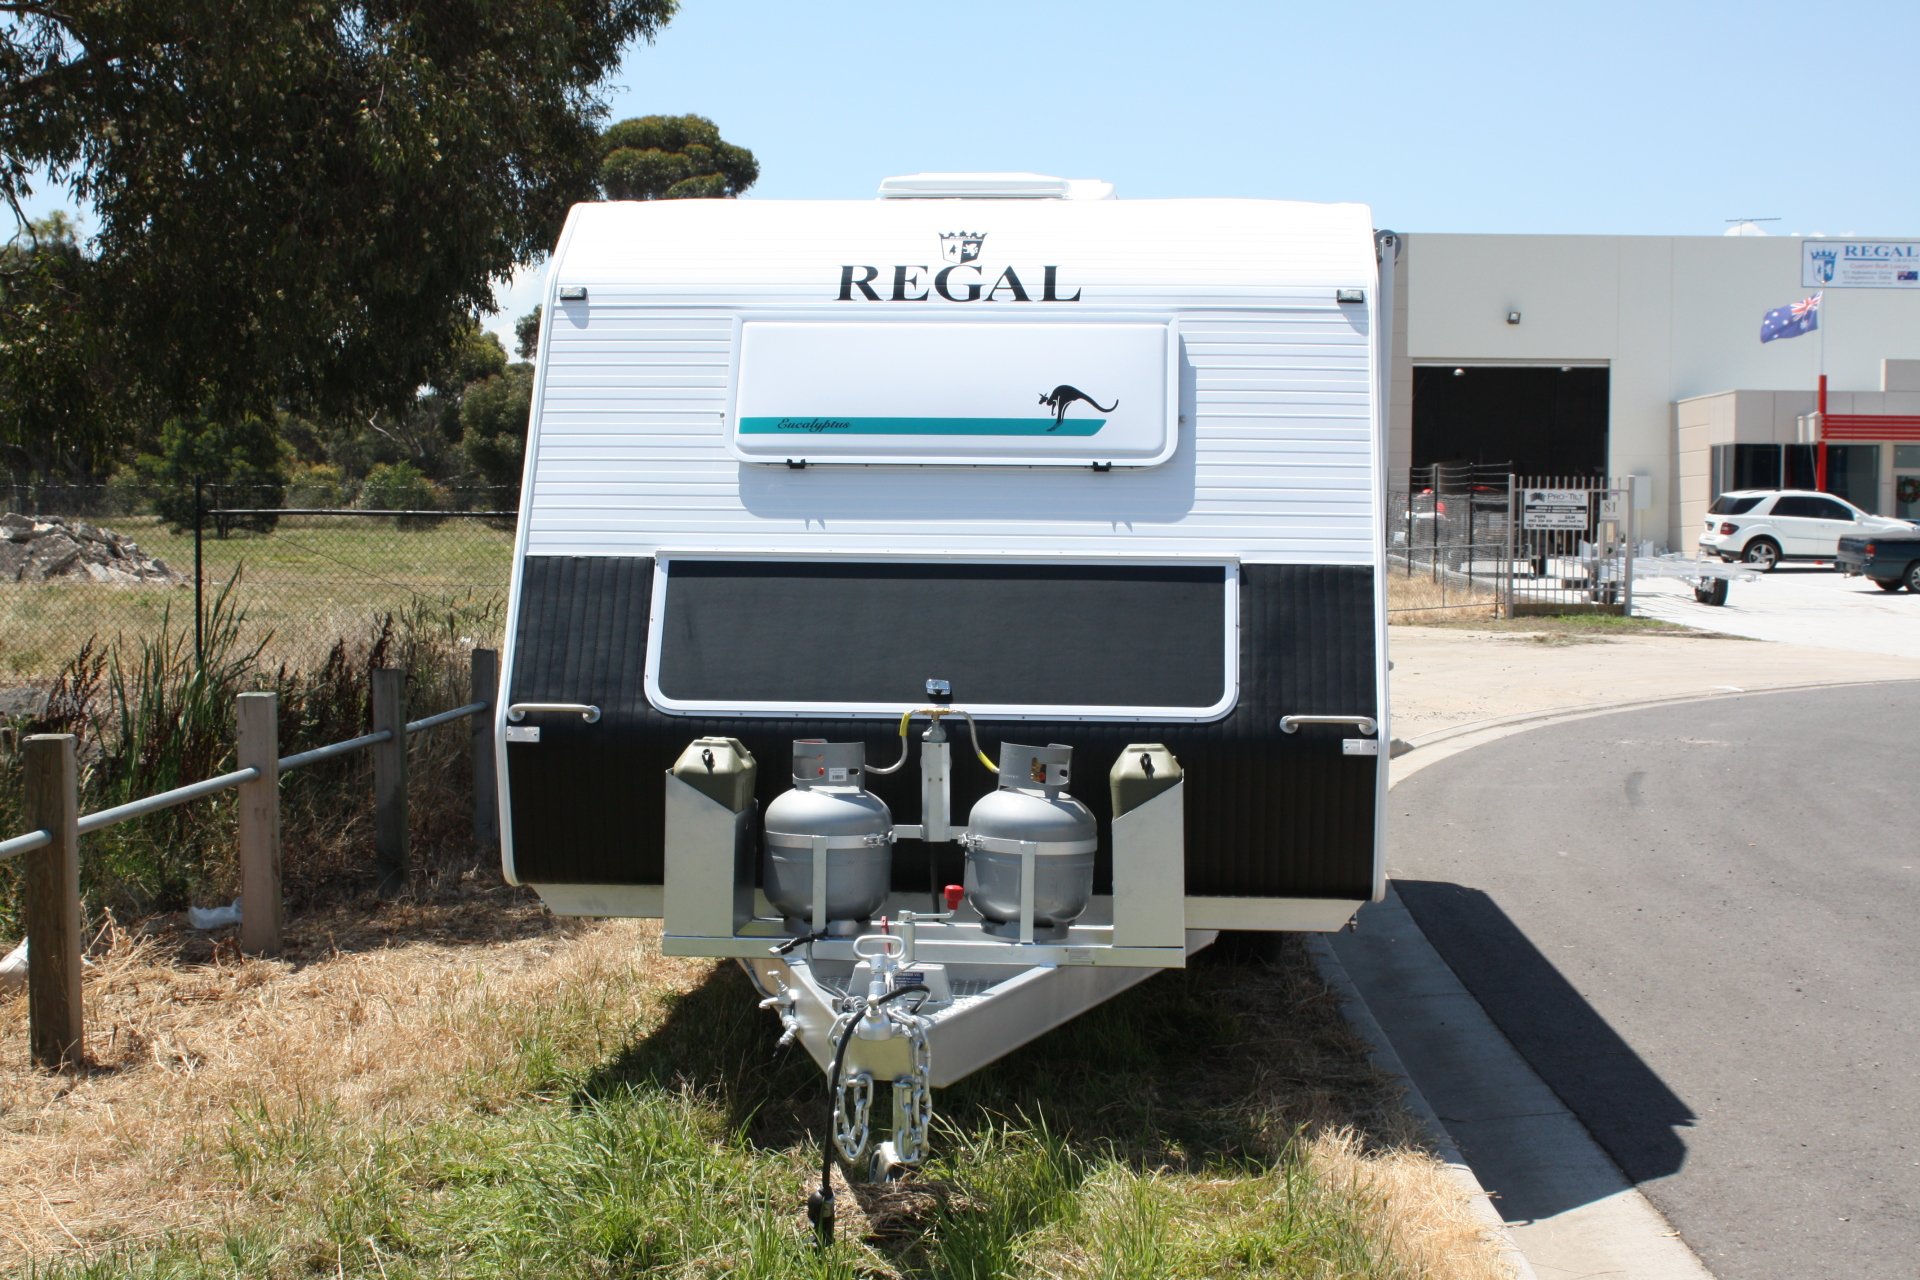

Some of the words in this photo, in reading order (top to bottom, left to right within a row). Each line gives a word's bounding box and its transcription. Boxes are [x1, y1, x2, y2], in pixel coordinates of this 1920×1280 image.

[1845, 245, 1919, 257] REGAL
[833, 265, 1082, 302] REGAL
[778, 418, 850, 433] Eucalyptus
[1604, 502, 1616, 512] 81
